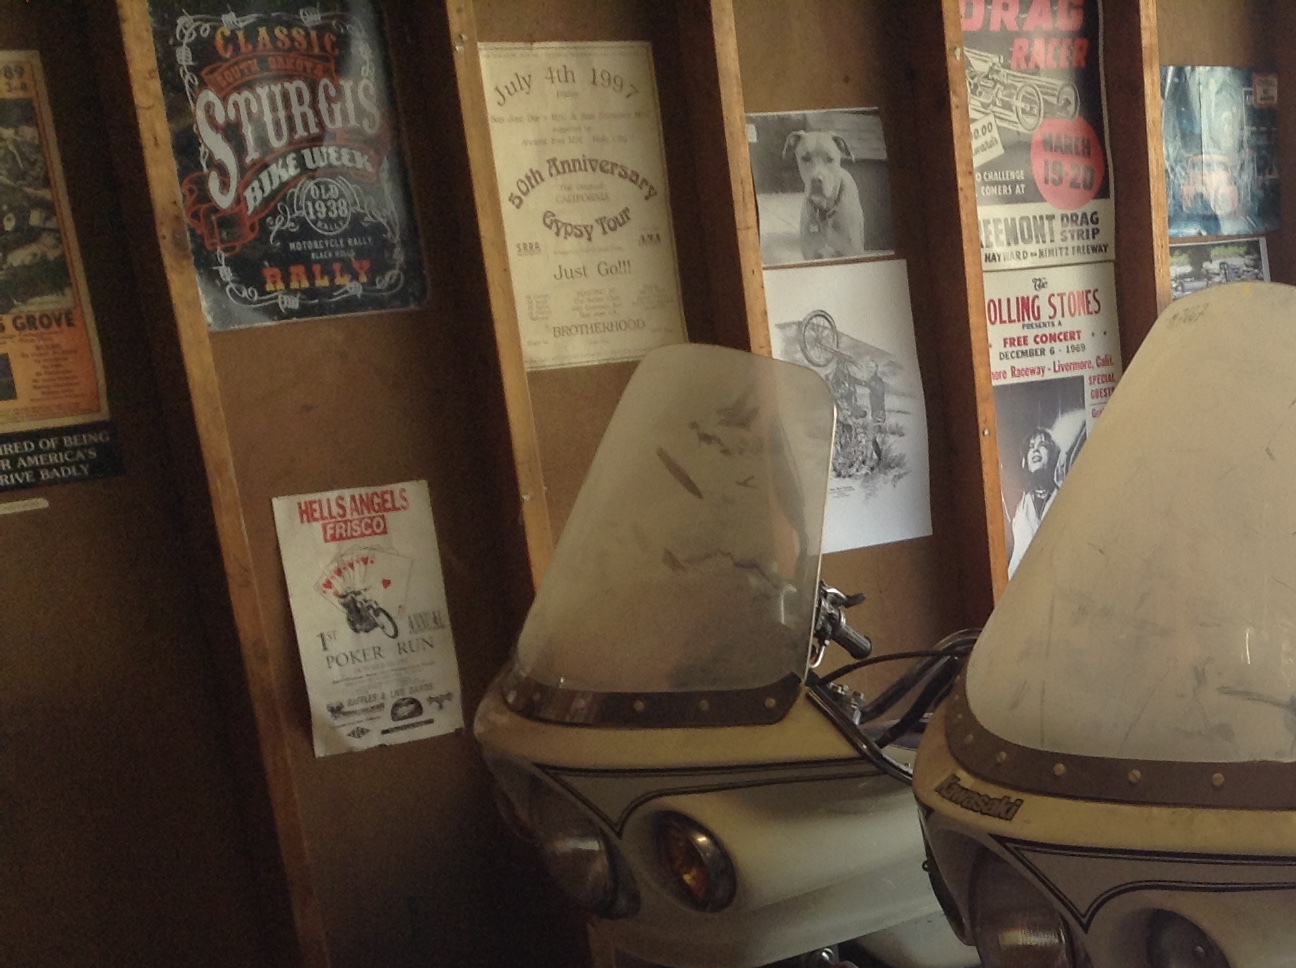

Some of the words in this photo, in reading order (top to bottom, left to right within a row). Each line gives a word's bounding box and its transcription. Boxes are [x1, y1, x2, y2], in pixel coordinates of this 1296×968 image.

[959, 0, 1084, 32] DRAG
[214, 25, 339, 59] CLASSIC
[494, 72, 532, 107] July
[545, 65, 576, 84] 4th
[591, 67, 640, 98] 1997
[196, 77, 381, 209] STURGIS
[1042, 133, 1091, 158] MARCH
[243, 152, 301, 215] BIKE
[301, 146, 374, 173] WEEK
[508, 167, 545, 209] 50th
[546, 154, 658, 201] Anniversary
[983, 170, 1025, 182] CHALLENGE
[1043, 160, 1095, 191] 19-20
[310, 184, 339, 200] OLD
[981, 185, 1012, 196] COMERS
[1015, 184, 1026, 194] AT
[305, 198, 348, 220] 1938
[1060, 211, 1099, 227] DRAG
[542, 210, 594, 243] Gypsy
[594, 206, 631, 235] Tour
[981, 214, 1056, 248] EEMONT
[1060, 228, 1100, 242] STRIP
[289, 239, 345, 251] MOTORCYCLE
[347, 237, 372, 247] RALLY
[984, 250, 1028, 263] HAYWARD
[1038, 246, 1069, 259] NIMITZ
[1072, 243, 1109, 256] FREEWAY
[261, 260, 371, 291] RALLY
[554, 264, 589, 280] Just
[597, 259, 632, 278] Go!!!
[1048, 288, 1102, 320] STONES
[12, 310, 75, 331] GROVE
[552, 318, 646, 339] BROTHERHOOD
[1022, 322, 1055, 330] PRESENTS
[1003, 335, 1029, 348] FREE
[1033, 330, 1082, 345] CONCERT
[999, 347, 1046, 361] DECEMBER
[1049, 346, 1056, 355] 6
[1066, 343, 1086, 354] 1969
[1010, 366, 1045, 378] Raceway
[1088, 372, 1117, 386] SPECIAL
[39, 437, 58, 450] OF
[63, 430, 110, 448] BEING
[17, 447, 97, 468] AMERICA'S
[40, 463, 90, 481] BADLY
[297, 495, 347, 524] HELLS
[349, 488, 411, 517] ANGELS
[325, 517, 386, 540] FRISCO
[326, 645, 384, 669] POKER
[397, 635, 435, 655] RUN
